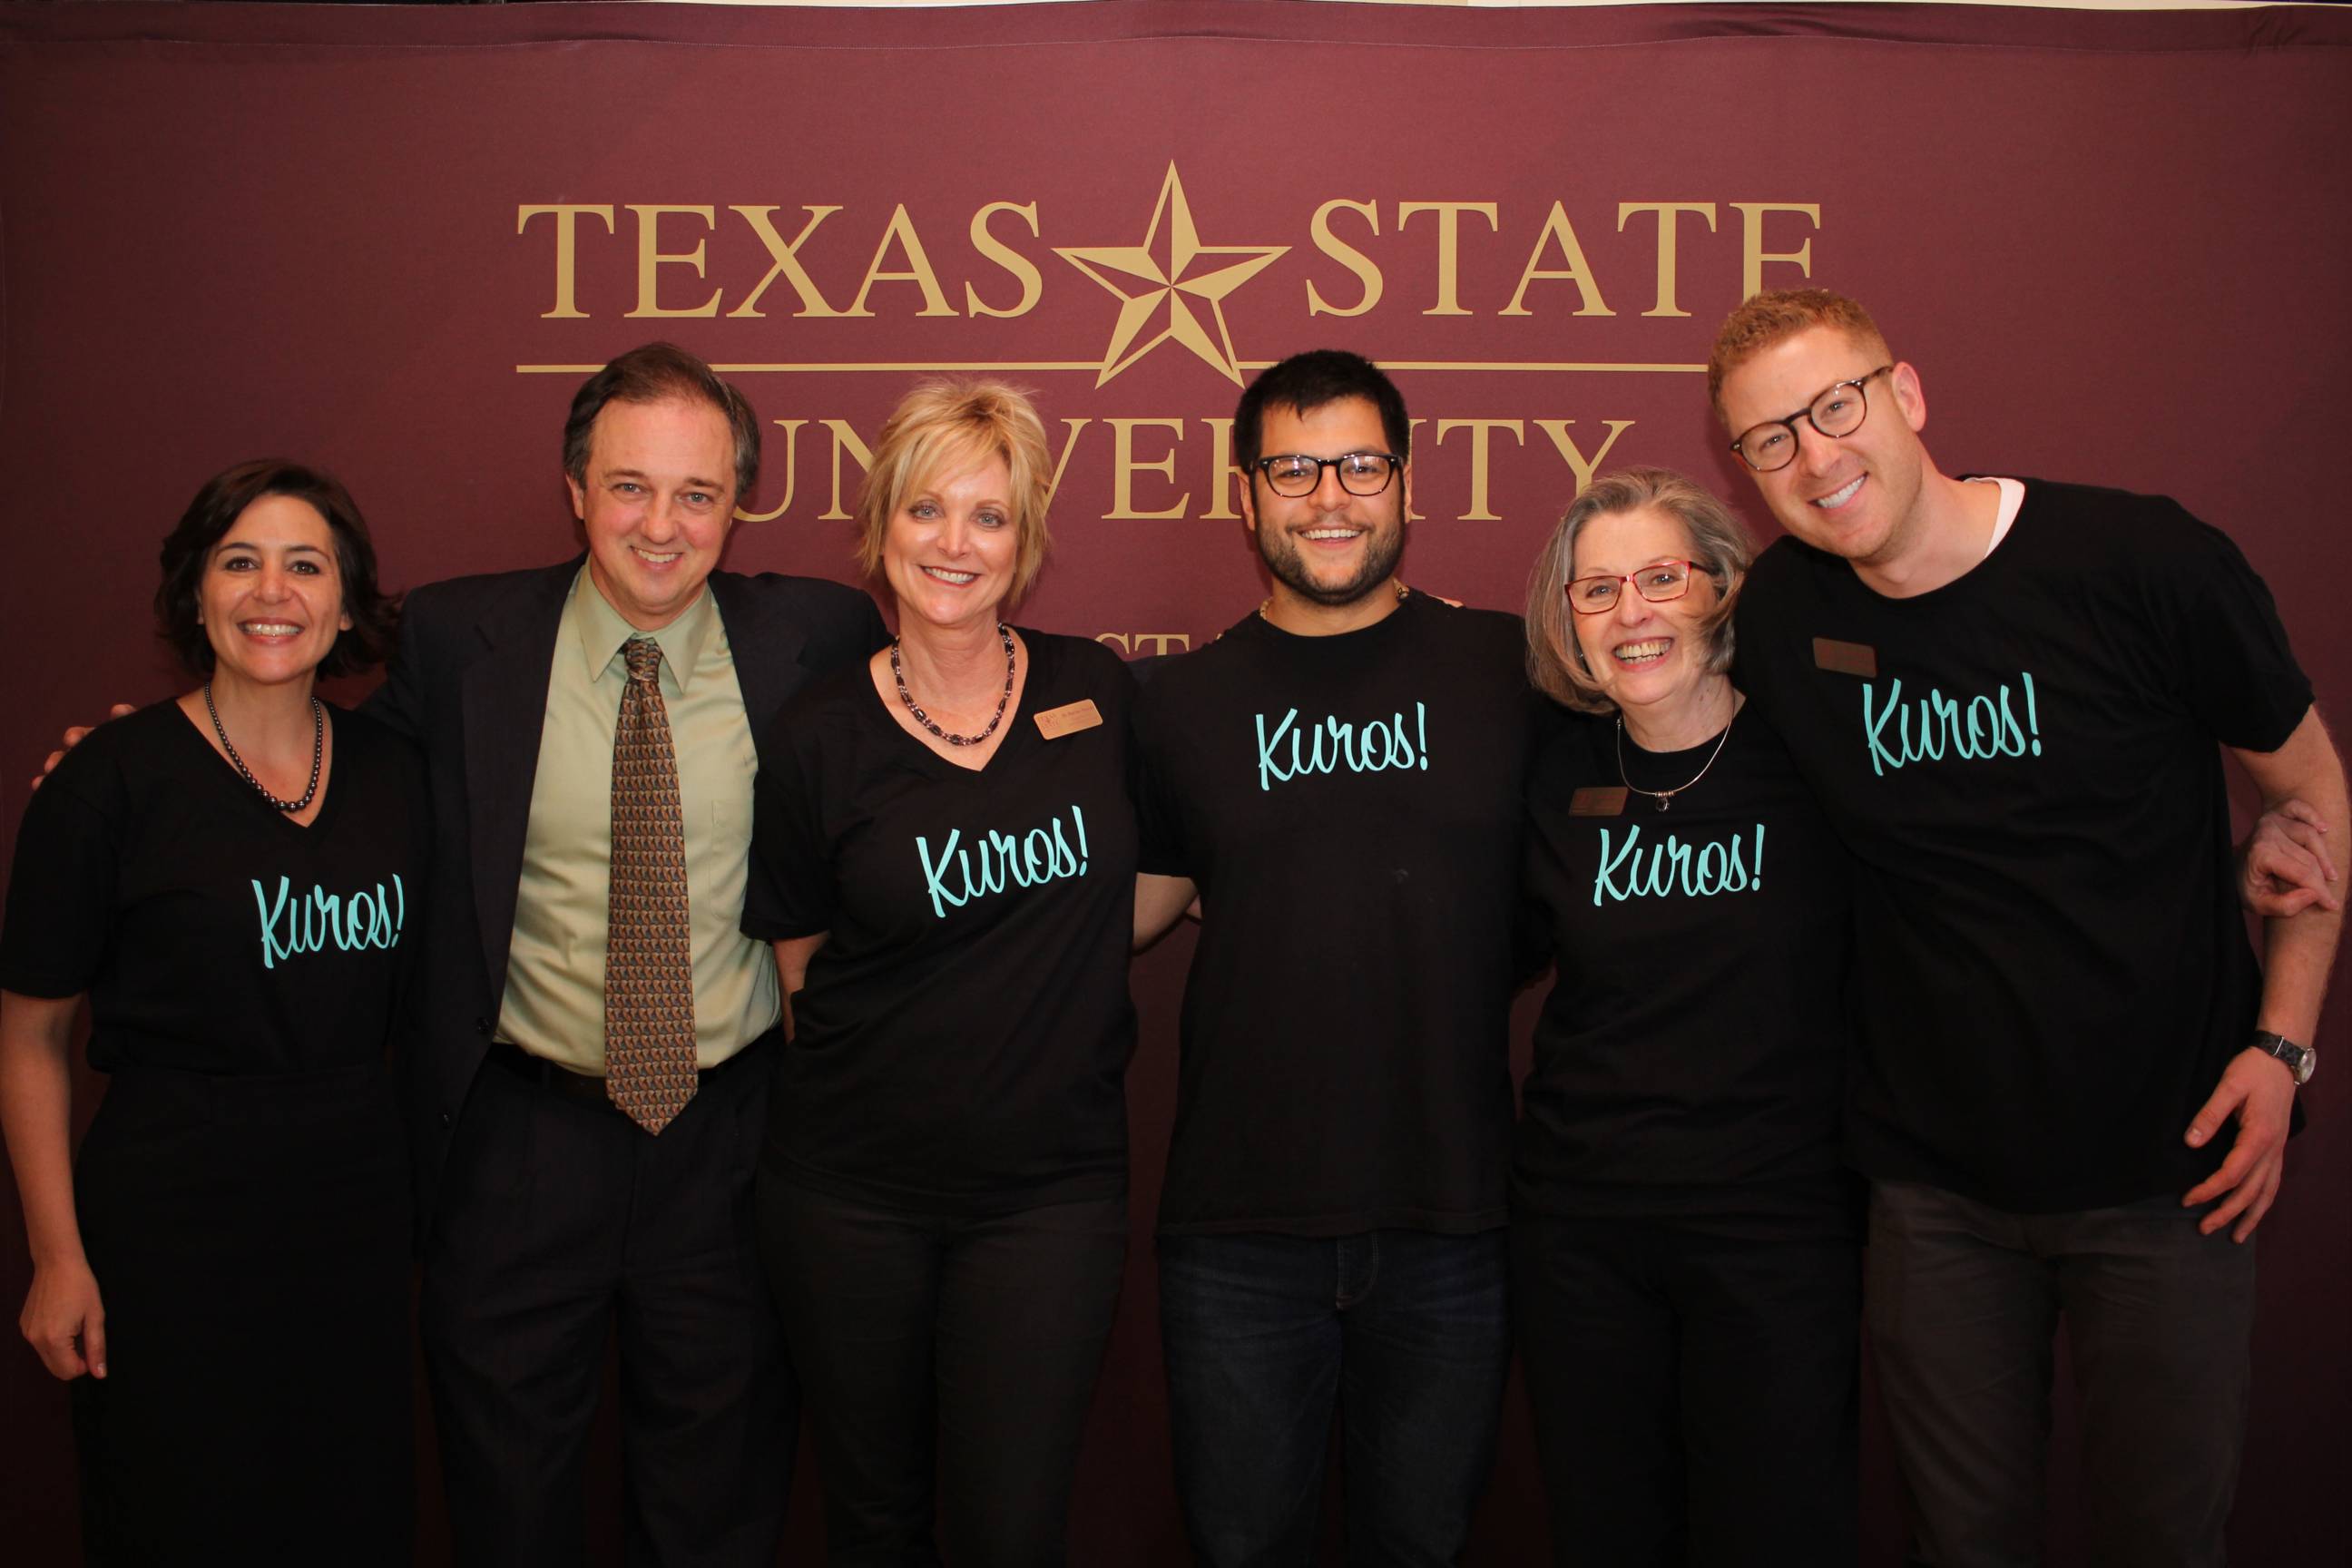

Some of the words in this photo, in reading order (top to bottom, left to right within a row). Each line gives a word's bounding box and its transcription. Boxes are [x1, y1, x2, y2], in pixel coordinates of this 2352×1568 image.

[517, 201, 1043, 318] TEXAS
[1306, 199, 1821, 317] STATE
[1256, 701, 1428, 791] Kuros!
[1863, 671, 2042, 777] Kuros!
[916, 805, 1089, 918] Kuros!
[1593, 823, 1765, 907] Kuros!
[251, 873, 405, 969] Kuros!
